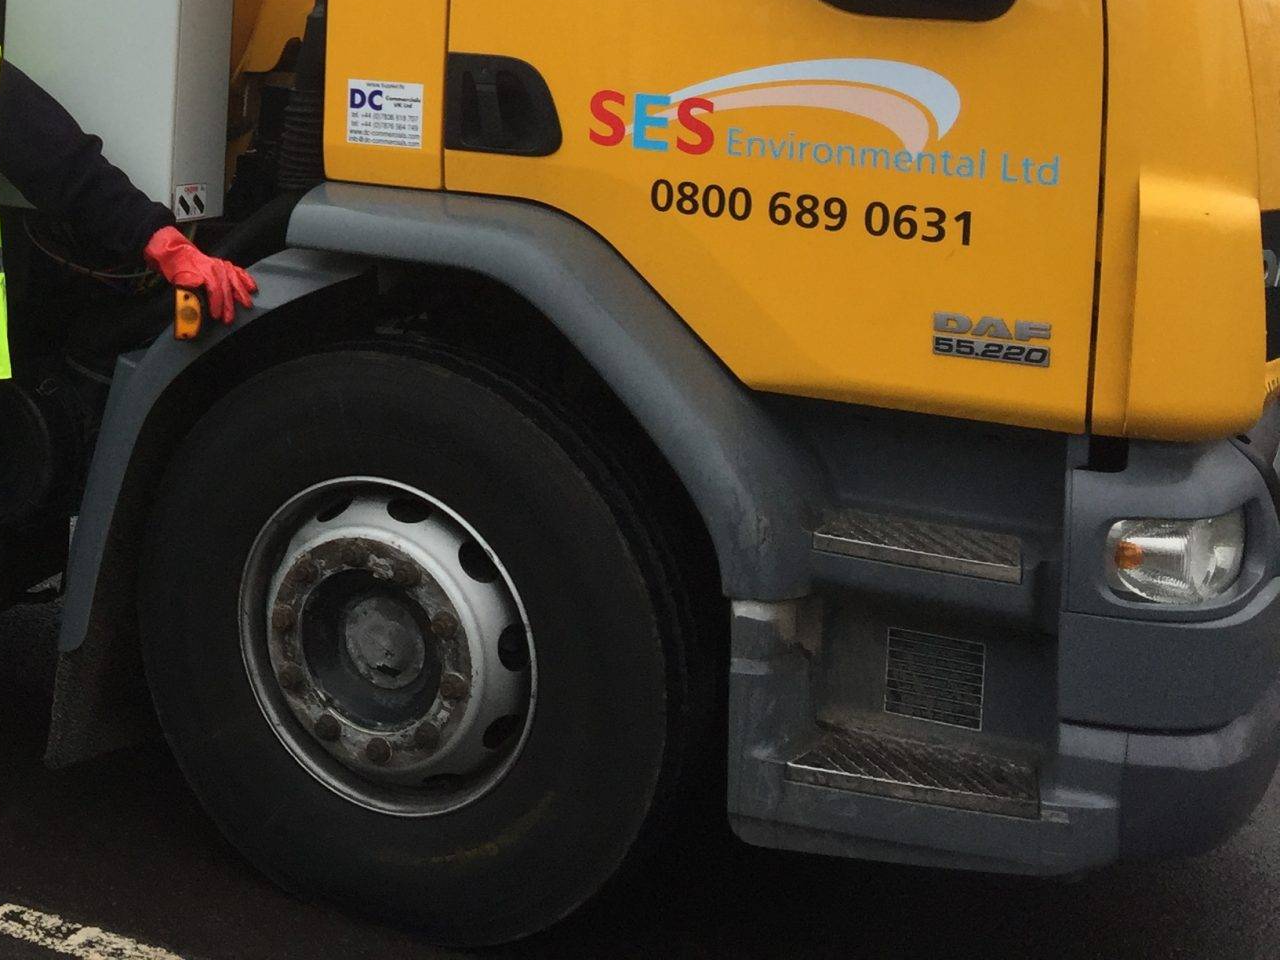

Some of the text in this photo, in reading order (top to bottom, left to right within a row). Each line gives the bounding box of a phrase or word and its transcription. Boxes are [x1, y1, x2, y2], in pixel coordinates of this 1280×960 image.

[350, 88, 383, 111] DC
[588, 89, 1060, 187] SES Environmental Ltd
[650, 178, 973, 246] 0800 689 0631
[932, 311, 1052, 341] DAF
[933, 336, 1050, 364] 55.220
